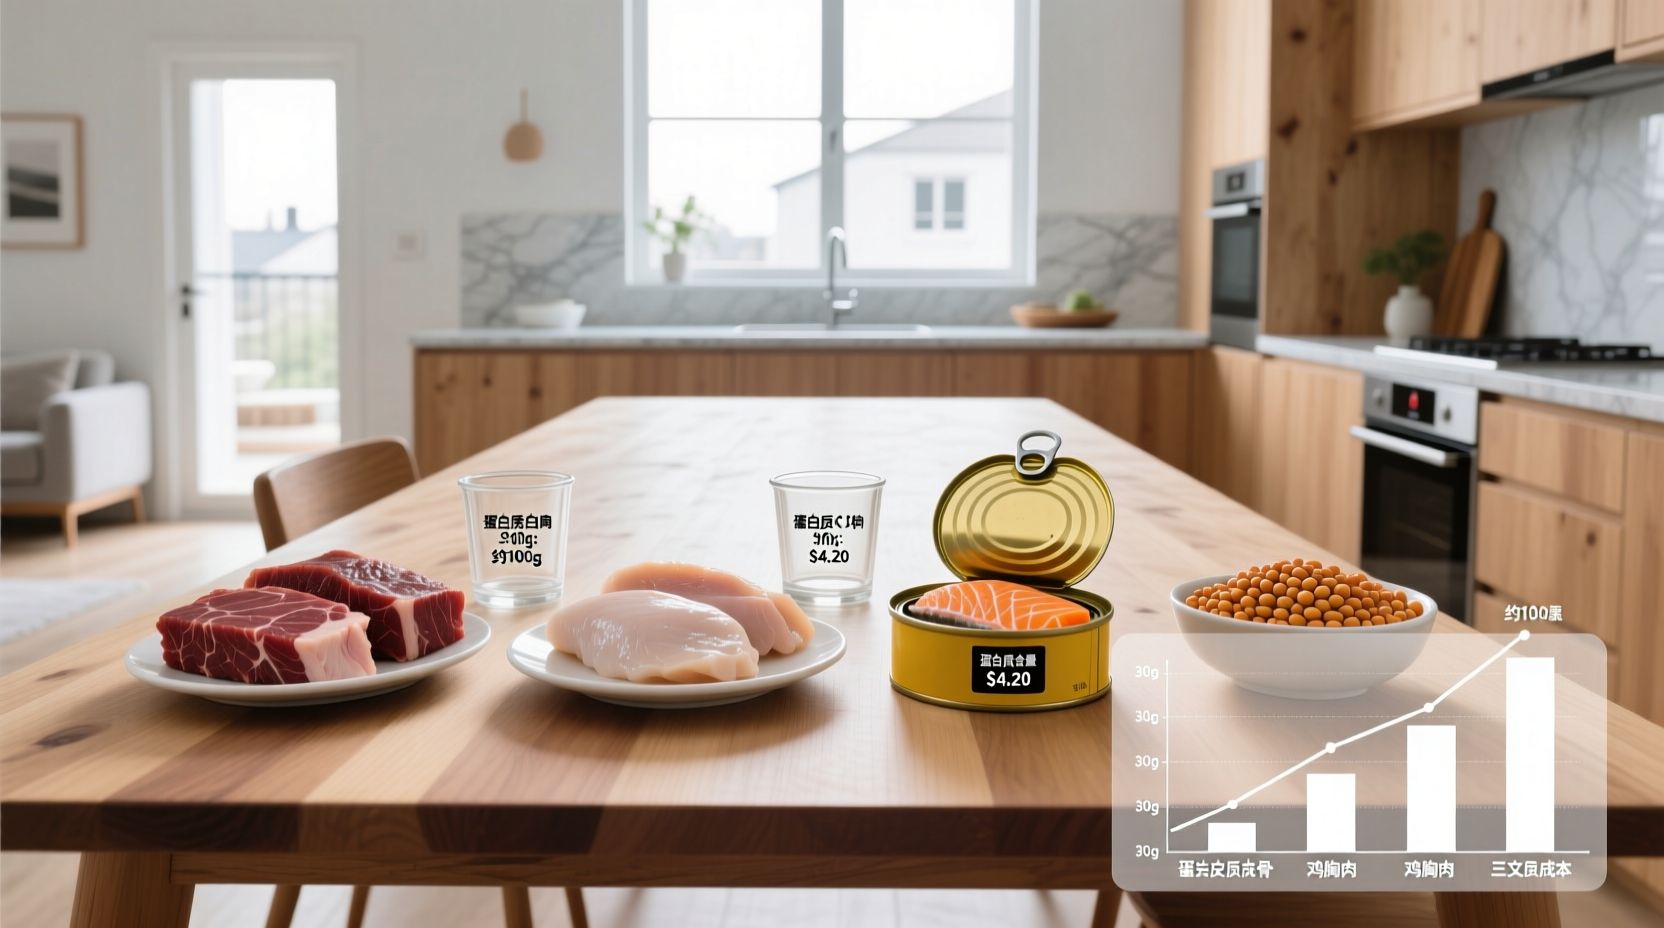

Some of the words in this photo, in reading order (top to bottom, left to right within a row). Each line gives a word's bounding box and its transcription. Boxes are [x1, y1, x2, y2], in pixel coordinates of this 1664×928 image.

[491, 549, 542, 567] 约100g
[809, 549, 850, 563] $4.20
[986, 671, 1031, 687] $4.20
